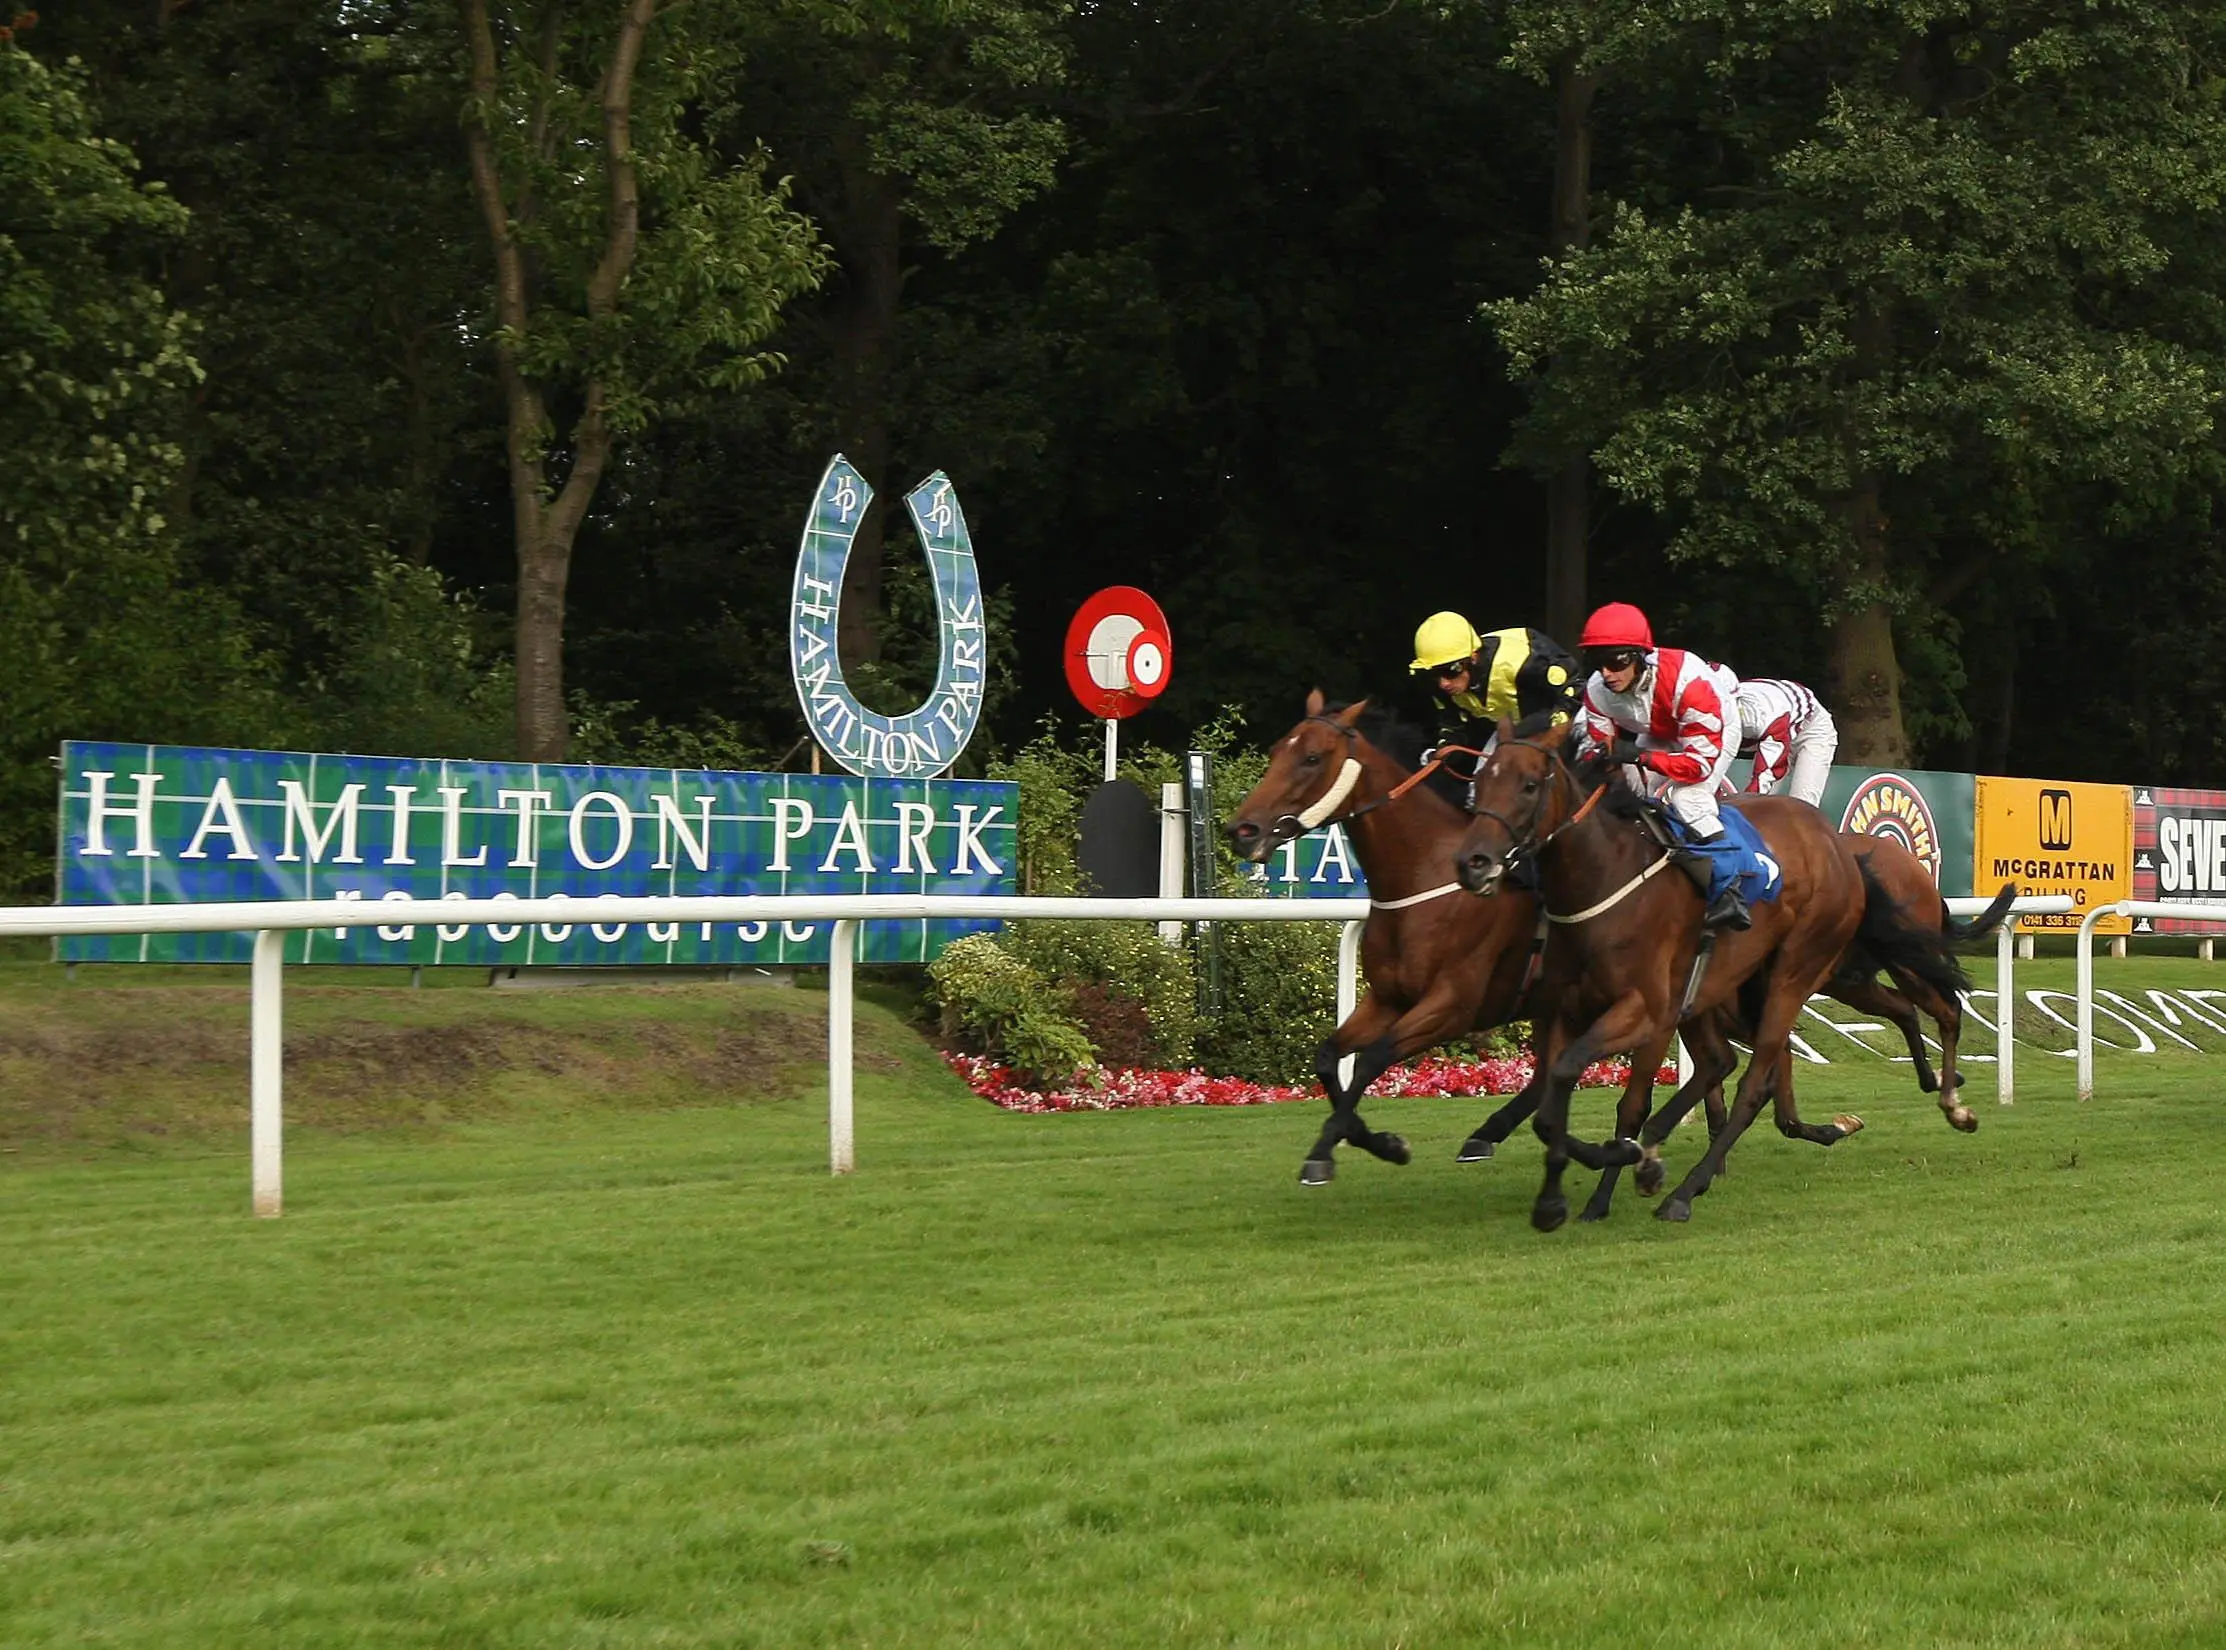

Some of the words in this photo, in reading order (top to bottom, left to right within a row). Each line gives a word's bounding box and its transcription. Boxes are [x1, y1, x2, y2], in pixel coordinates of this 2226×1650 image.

[799, 573, 941, 774] HAMILTON
[936, 594, 981, 742] PARK
[80, 771, 716, 871] HAMILTON
[766, 797, 1004, 876] PARK
